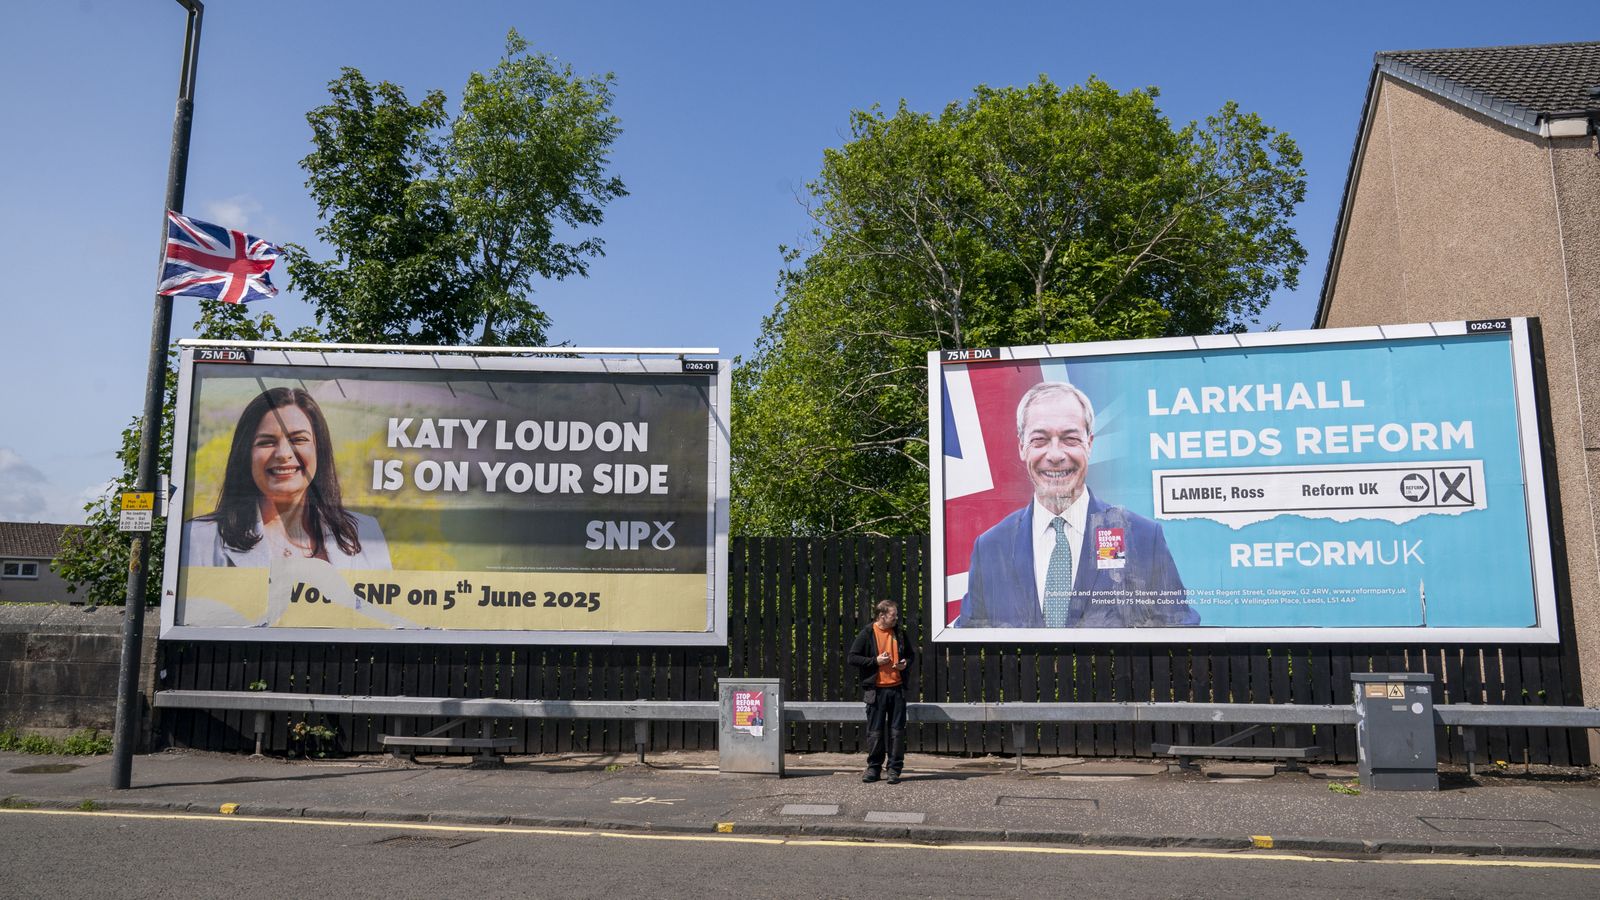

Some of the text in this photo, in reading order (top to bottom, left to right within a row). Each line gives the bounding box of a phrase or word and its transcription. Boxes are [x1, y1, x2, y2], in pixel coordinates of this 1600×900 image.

[1471, 321, 1506, 330] 0262-02
[1147, 380, 1364, 416] LARKHALL
[388, 418, 649, 453] KATY LOUDON
[1149, 421, 1474, 460] NEEDS REFORM
[372, 460, 669, 495] IS ON YOUR SIDE
[1172, 485, 1265, 502] LAMBIE, Ross
[1302, 483, 1379, 497] Reform UK
[585, 520, 651, 550] SNP
[353, 583, 401, 605] SNP
[407, 589, 437, 605] on
[443, 580, 473, 610] 5th
[478, 585, 537, 607] June
[543, 591, 601, 612] 2025
[1216, 589, 1241, 598] Regent
[1242, 589, 1265, 597] Street,
[1266, 588, 1299, 597] Glasgow,
[1312, 588, 1331, 596] 4RW,
[1332, 587, 1407, 596] www.reformparty.uk
[1241, 597, 1279, 606] Wellington
[1280, 597, 1301, 605] Place,
[1303, 597, 1326, 605] Leeds,
[1327, 596, 1339, 604] LS1
[736, 692, 751, 700] STOP
